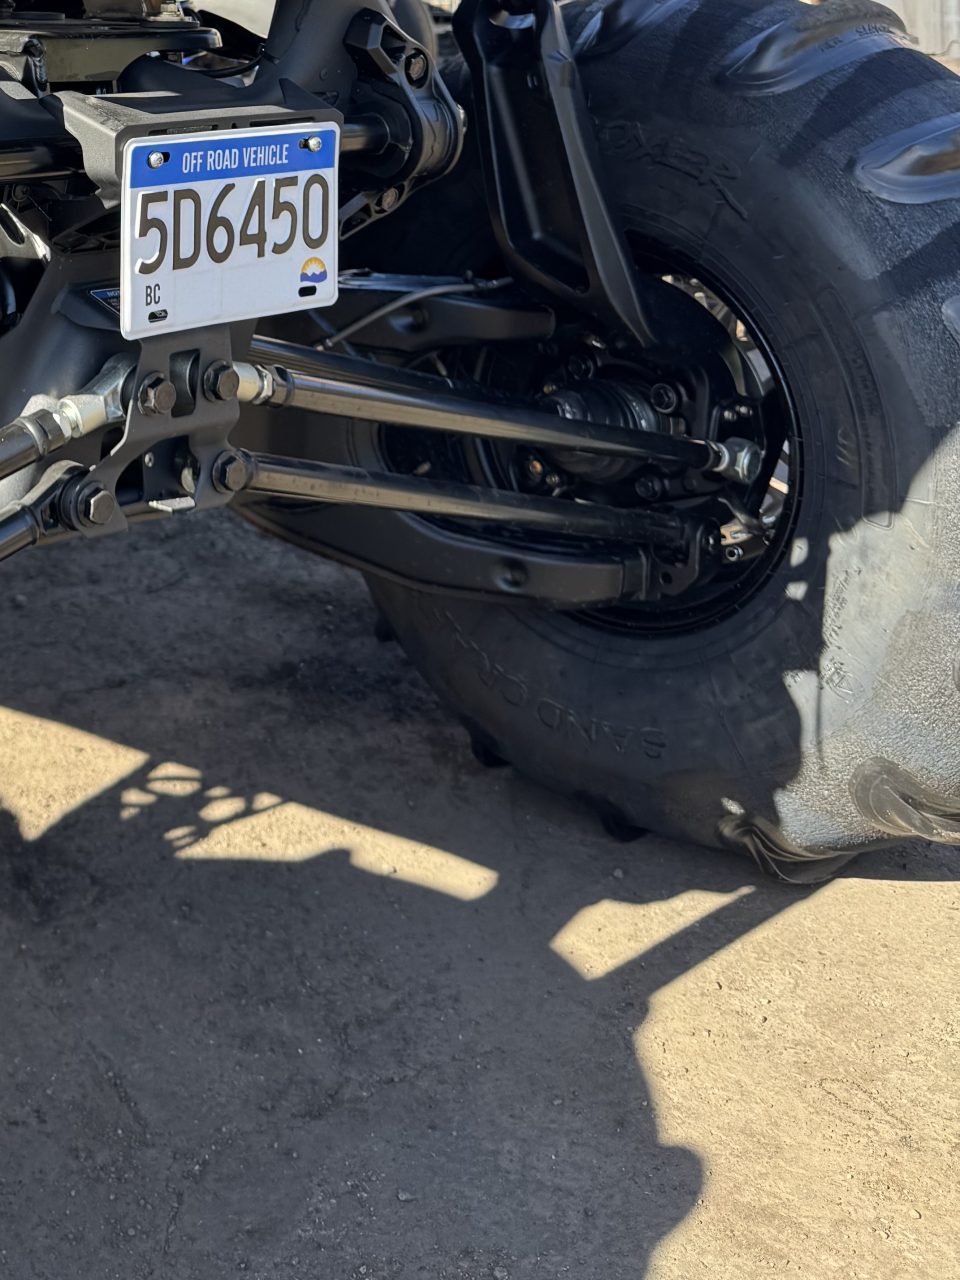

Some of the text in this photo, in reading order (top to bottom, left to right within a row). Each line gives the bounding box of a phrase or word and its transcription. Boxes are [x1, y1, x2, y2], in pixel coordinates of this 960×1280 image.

[182, 144, 290, 174] OFF ROAD VEHICLE
[135, 173, 329, 275] 5D6450
[145, 283, 161, 306] BC
